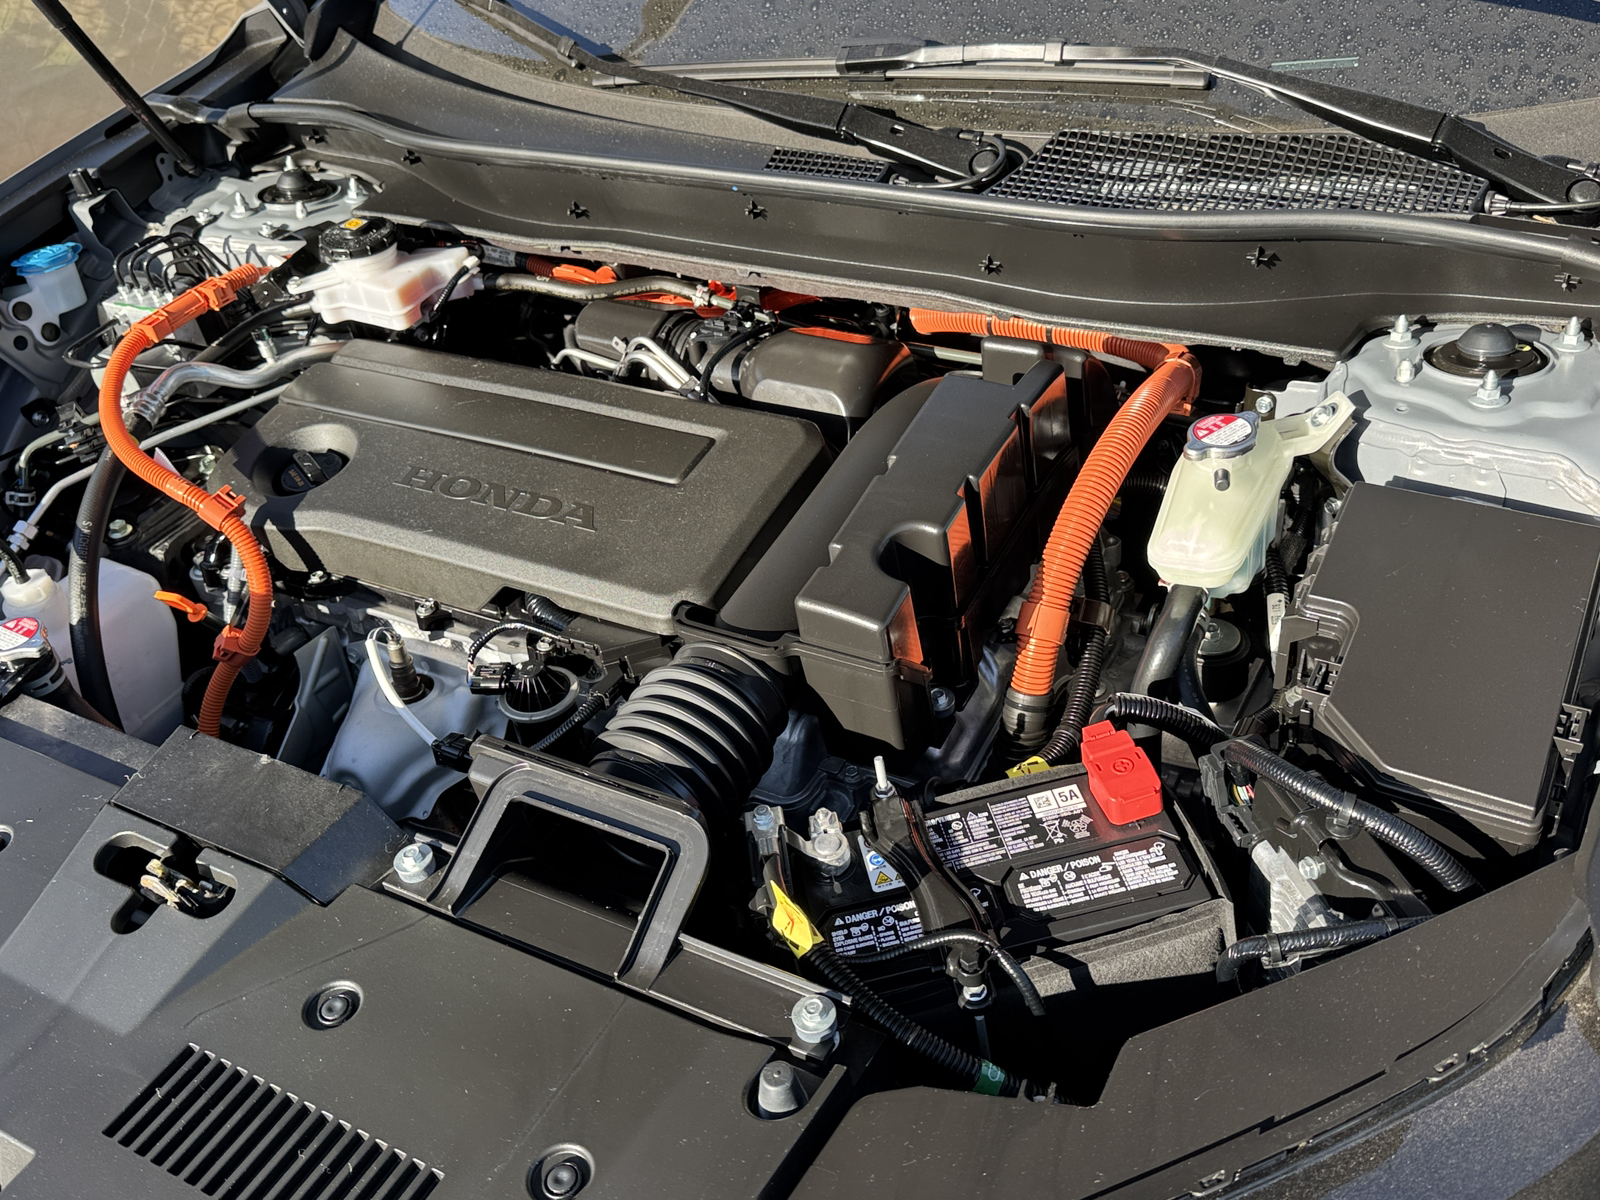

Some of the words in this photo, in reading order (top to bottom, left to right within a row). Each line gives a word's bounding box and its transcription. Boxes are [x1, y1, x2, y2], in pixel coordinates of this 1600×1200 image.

[392, 465, 598, 533] HONDA
[1058, 789, 1080, 803] 5A
[1029, 864, 1064, 879] DANGER
[1070, 855, 1102, 870] POISON
[845, 910, 878, 924] DANGER
